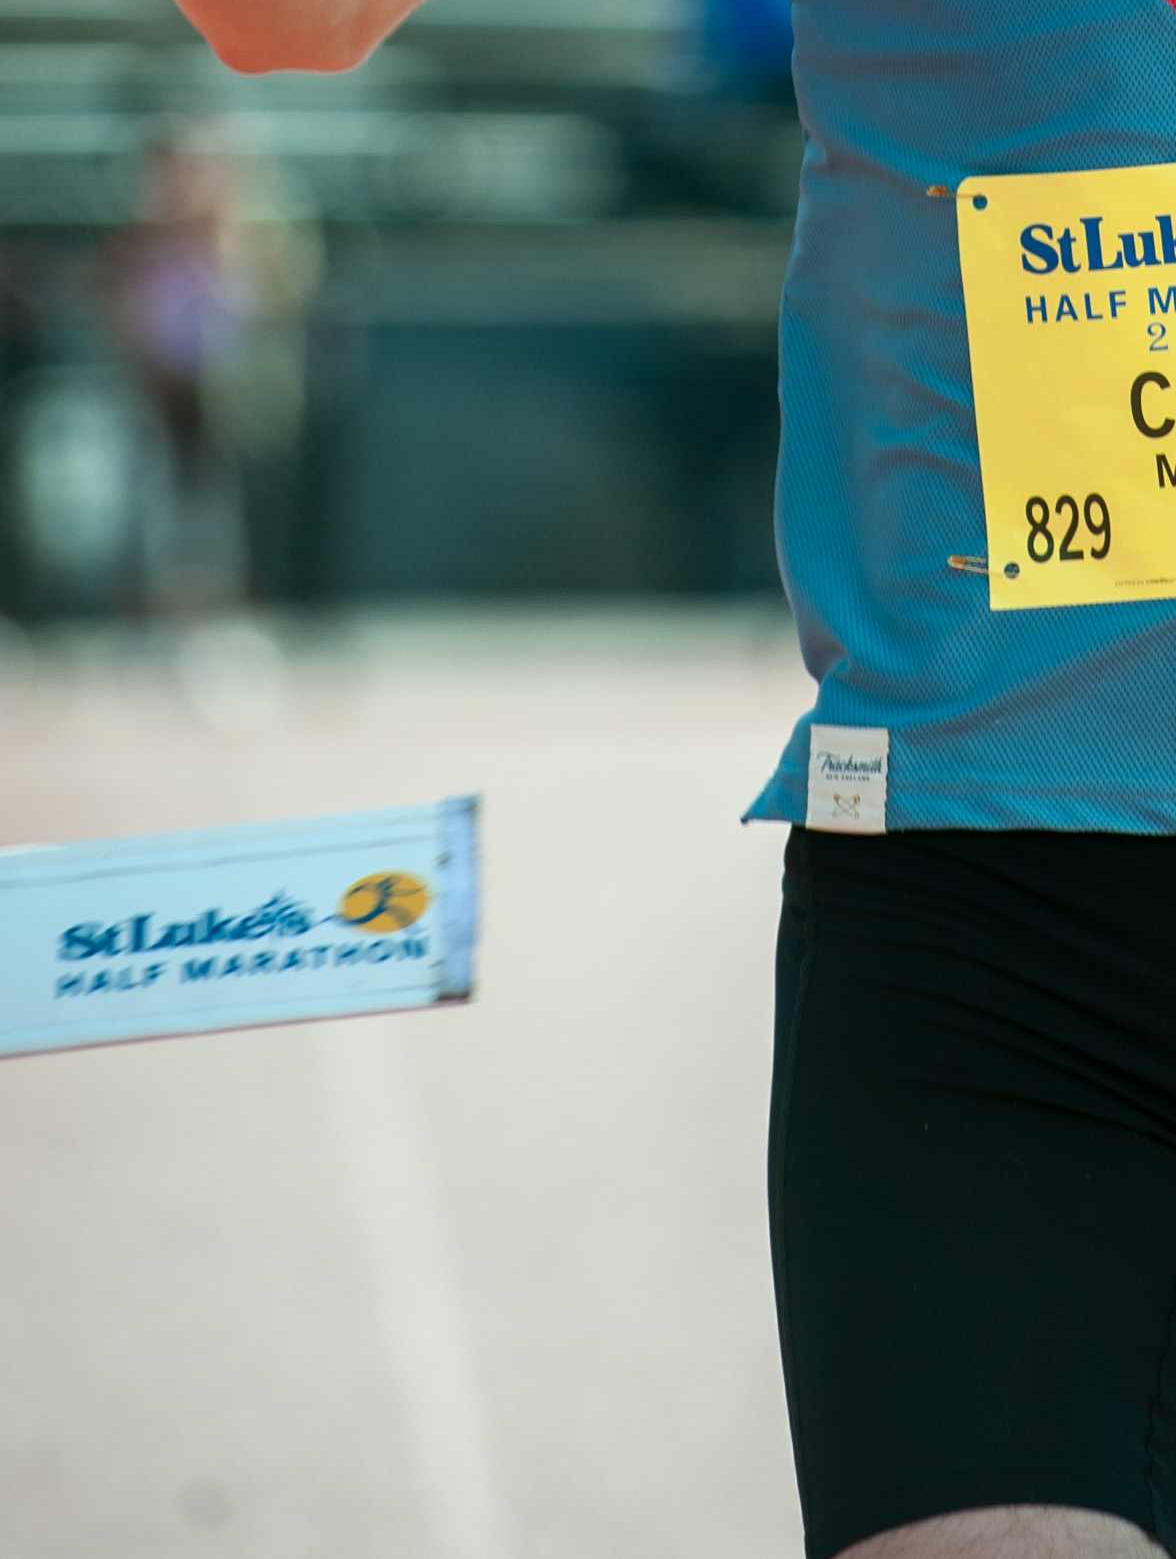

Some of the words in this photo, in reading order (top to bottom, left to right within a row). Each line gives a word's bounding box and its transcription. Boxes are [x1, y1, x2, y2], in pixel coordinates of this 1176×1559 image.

[1025, 289, 1128, 324] HALF
[1025, 492, 1112, 563] 829
[54, 960, 168, 1000] HALF
[178, 936, 431, 986] MARATHON
